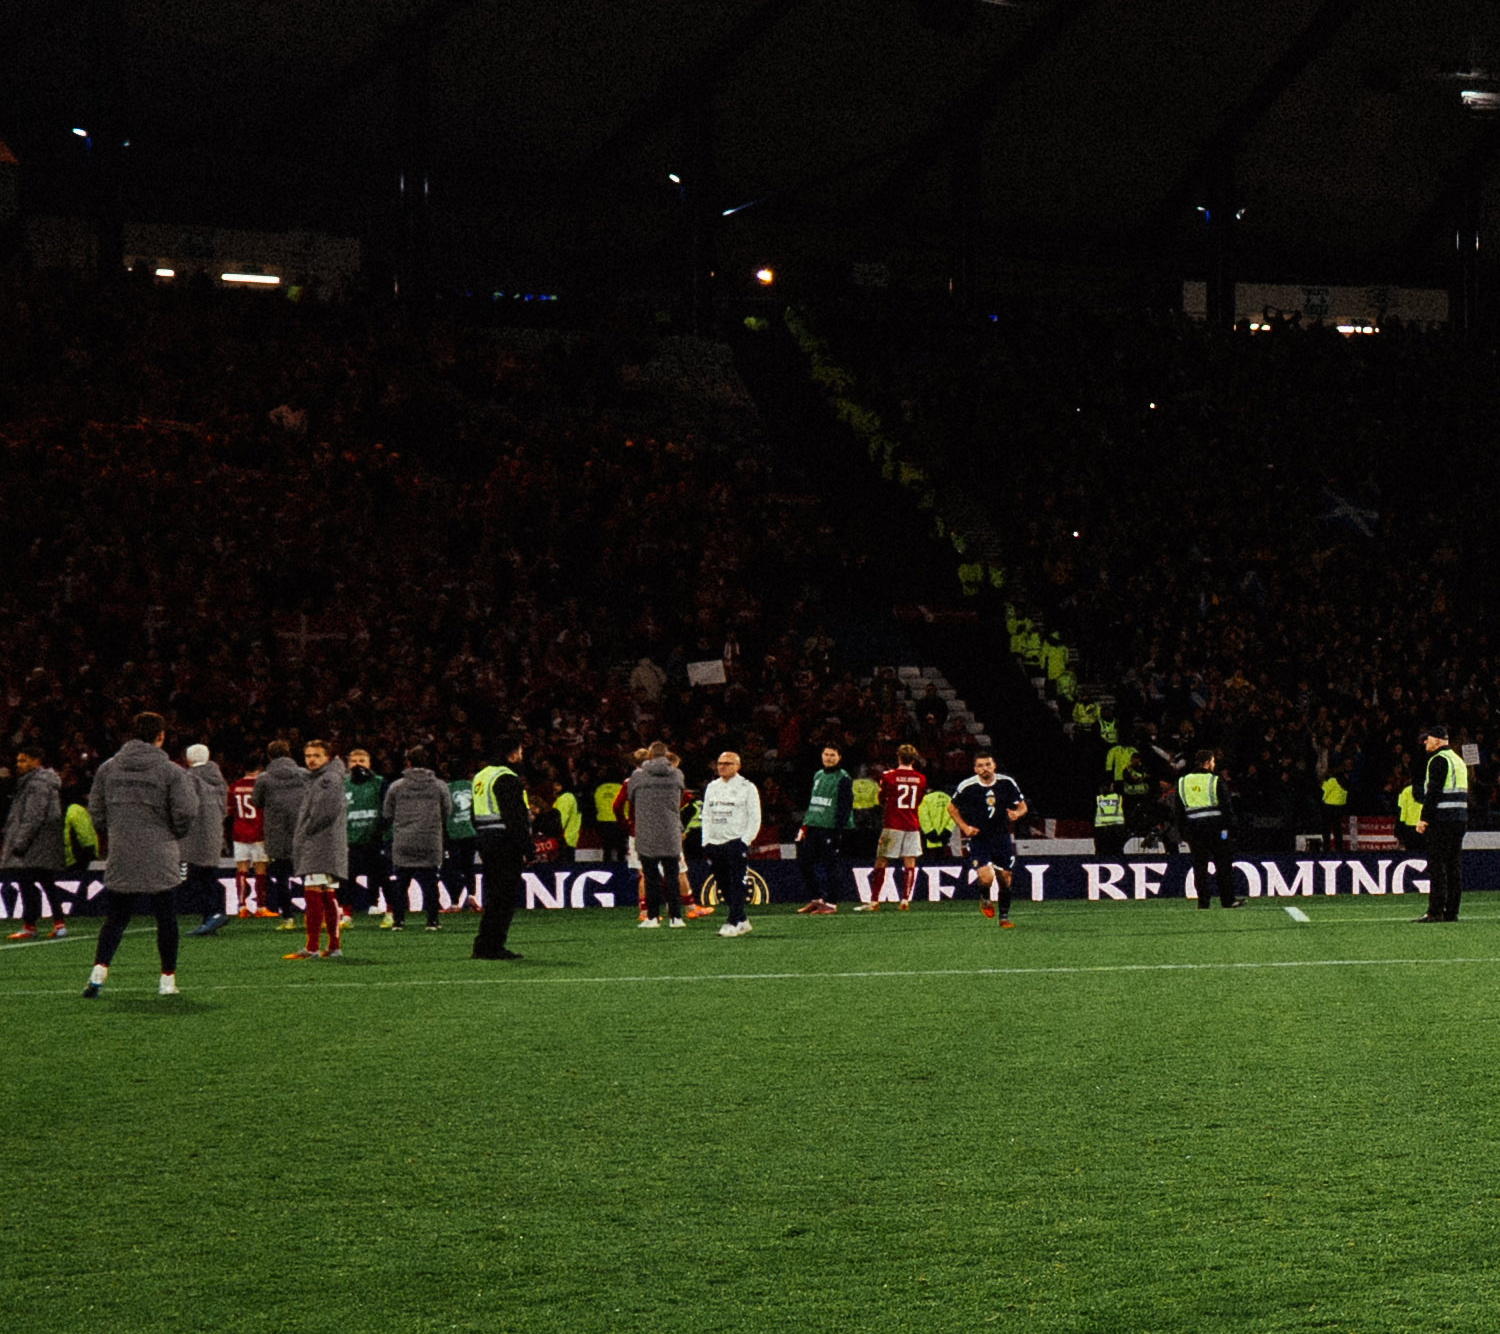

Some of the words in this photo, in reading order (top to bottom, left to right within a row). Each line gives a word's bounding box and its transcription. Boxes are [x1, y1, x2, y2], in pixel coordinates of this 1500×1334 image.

[235, 794, 257, 820] 15
[896, 783, 918, 810] 21
[986, 806, 997, 819] 7
